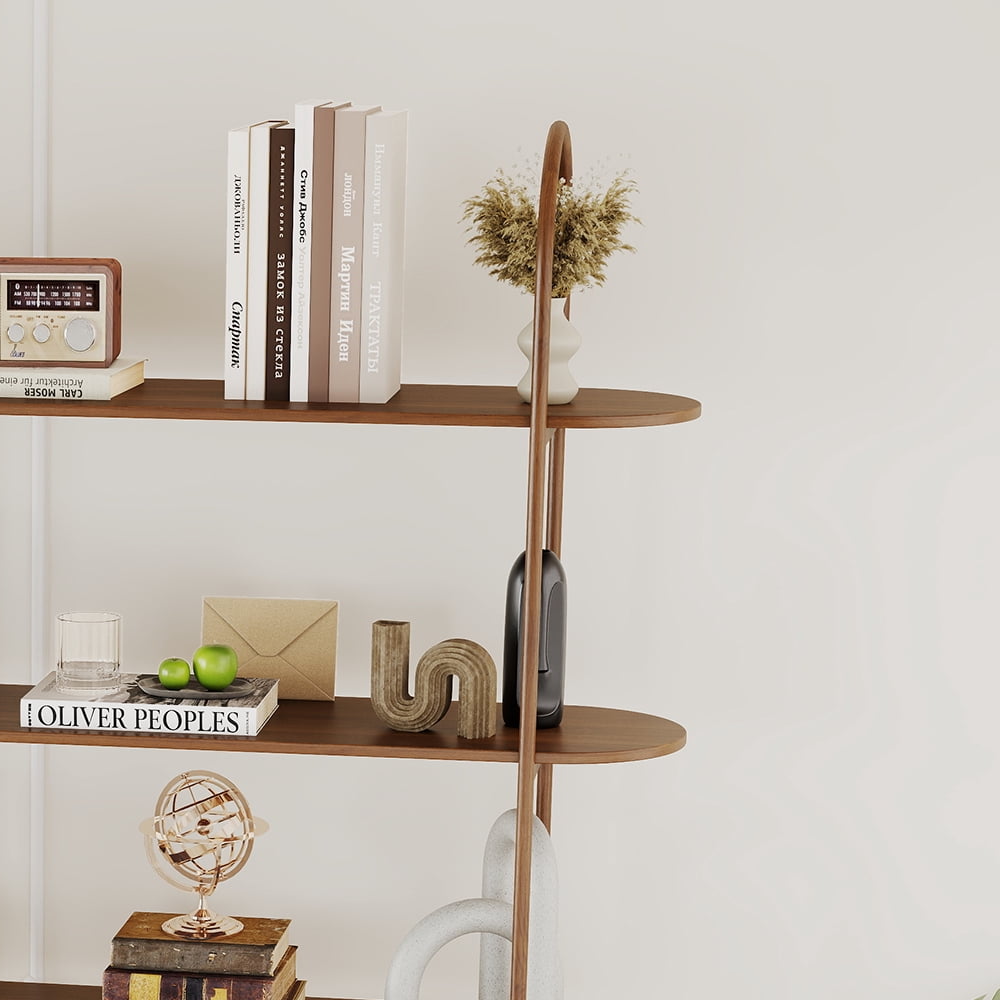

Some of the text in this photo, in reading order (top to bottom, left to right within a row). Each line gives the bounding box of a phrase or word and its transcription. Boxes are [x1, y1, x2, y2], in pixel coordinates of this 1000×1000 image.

[233, 174, 242, 254] ДЖОВАНЬОЛИ
[298, 169, 308, 243] Стив Джобс
[373, 222, 383, 257] Кант
[338, 246, 355, 362] Мартин Иден
[229, 301, 244, 369] Спартак
[367, 281, 382, 373] ТРАКТАТЫ
[0, 377, 19, 386] eine
[19, 377, 33, 388] für
[24, 387, 83, 398] CARL MOSER
[35, 378, 84, 388] Architektur
[37, 704, 127, 729] OLIVER
[134, 708, 240, 734] PEOPLES
